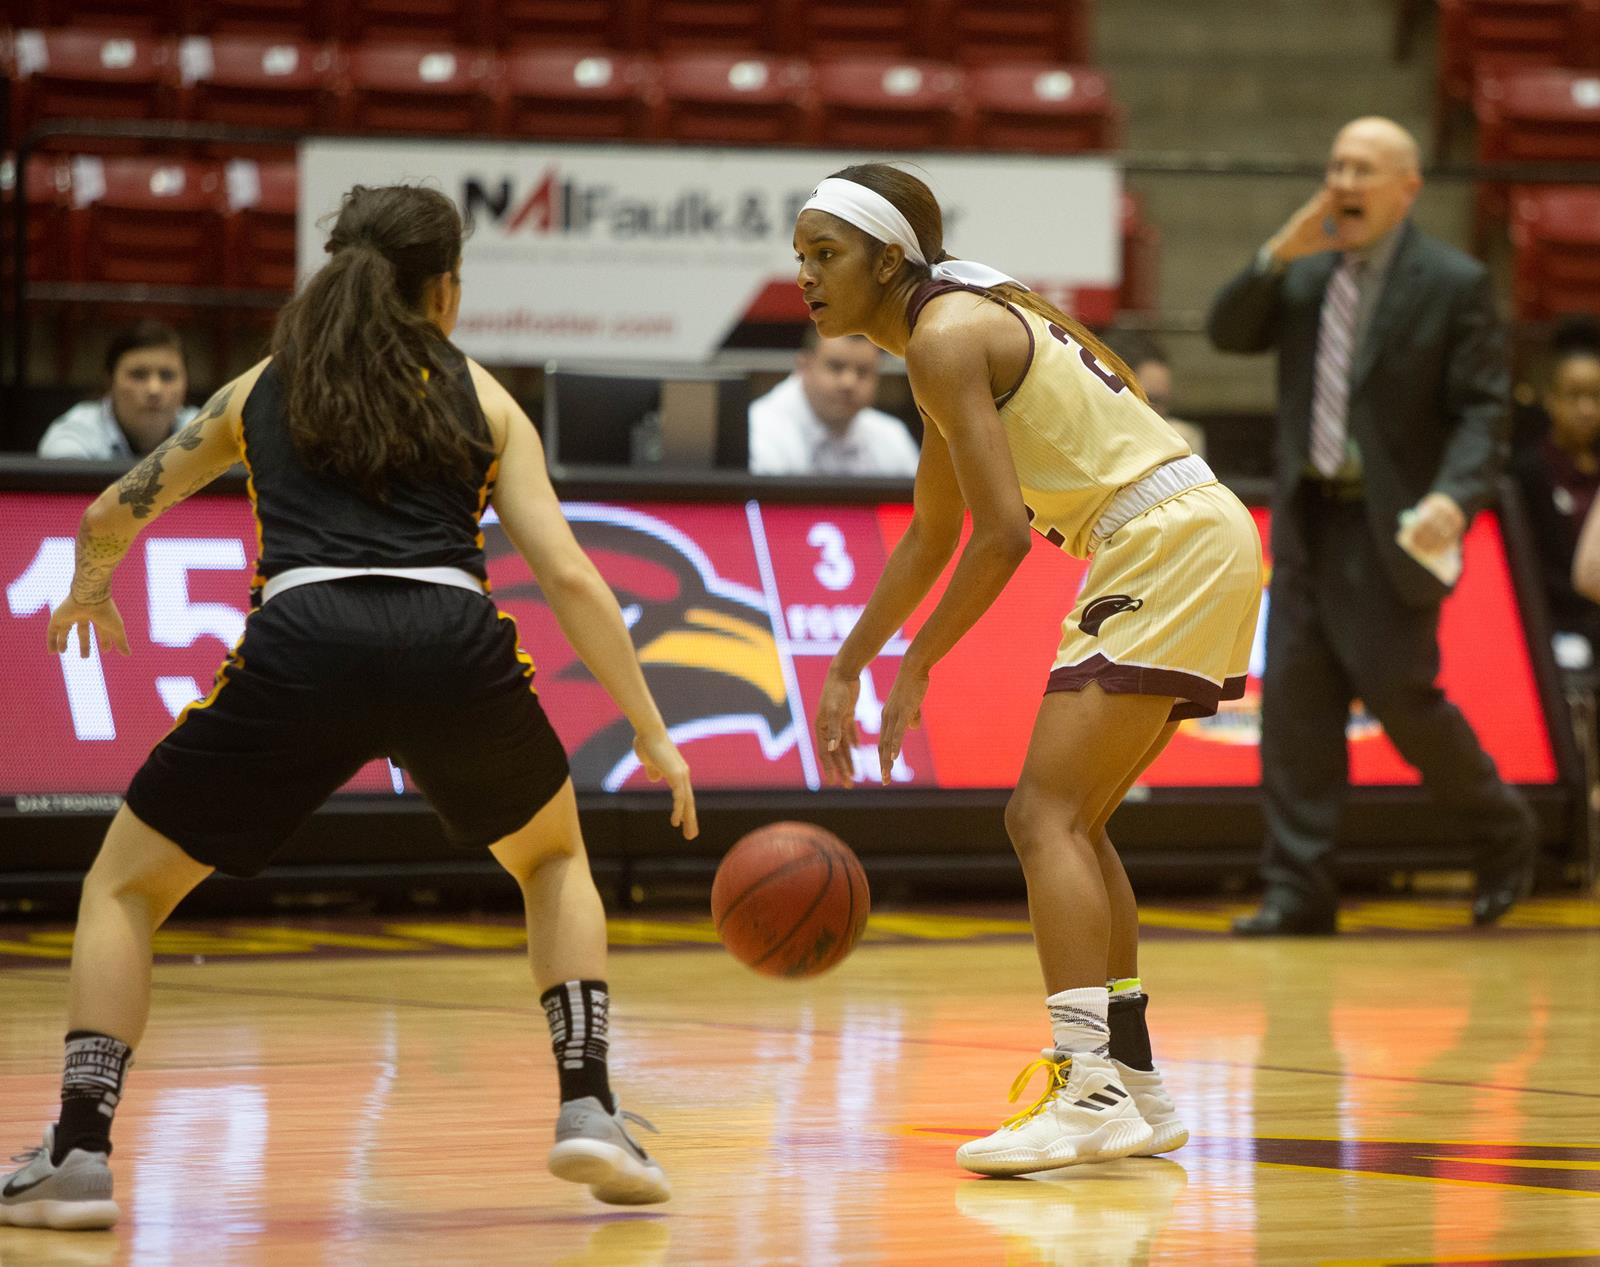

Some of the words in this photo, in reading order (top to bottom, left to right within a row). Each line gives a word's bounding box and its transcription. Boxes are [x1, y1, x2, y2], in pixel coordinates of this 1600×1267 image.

[738, 196, 771, 239] &
[458, 312, 675, 337] andfoster.com
[807, 522, 855, 591] 3
[6, 537, 247, 740] 15
[786, 604, 904, 640] FOU
